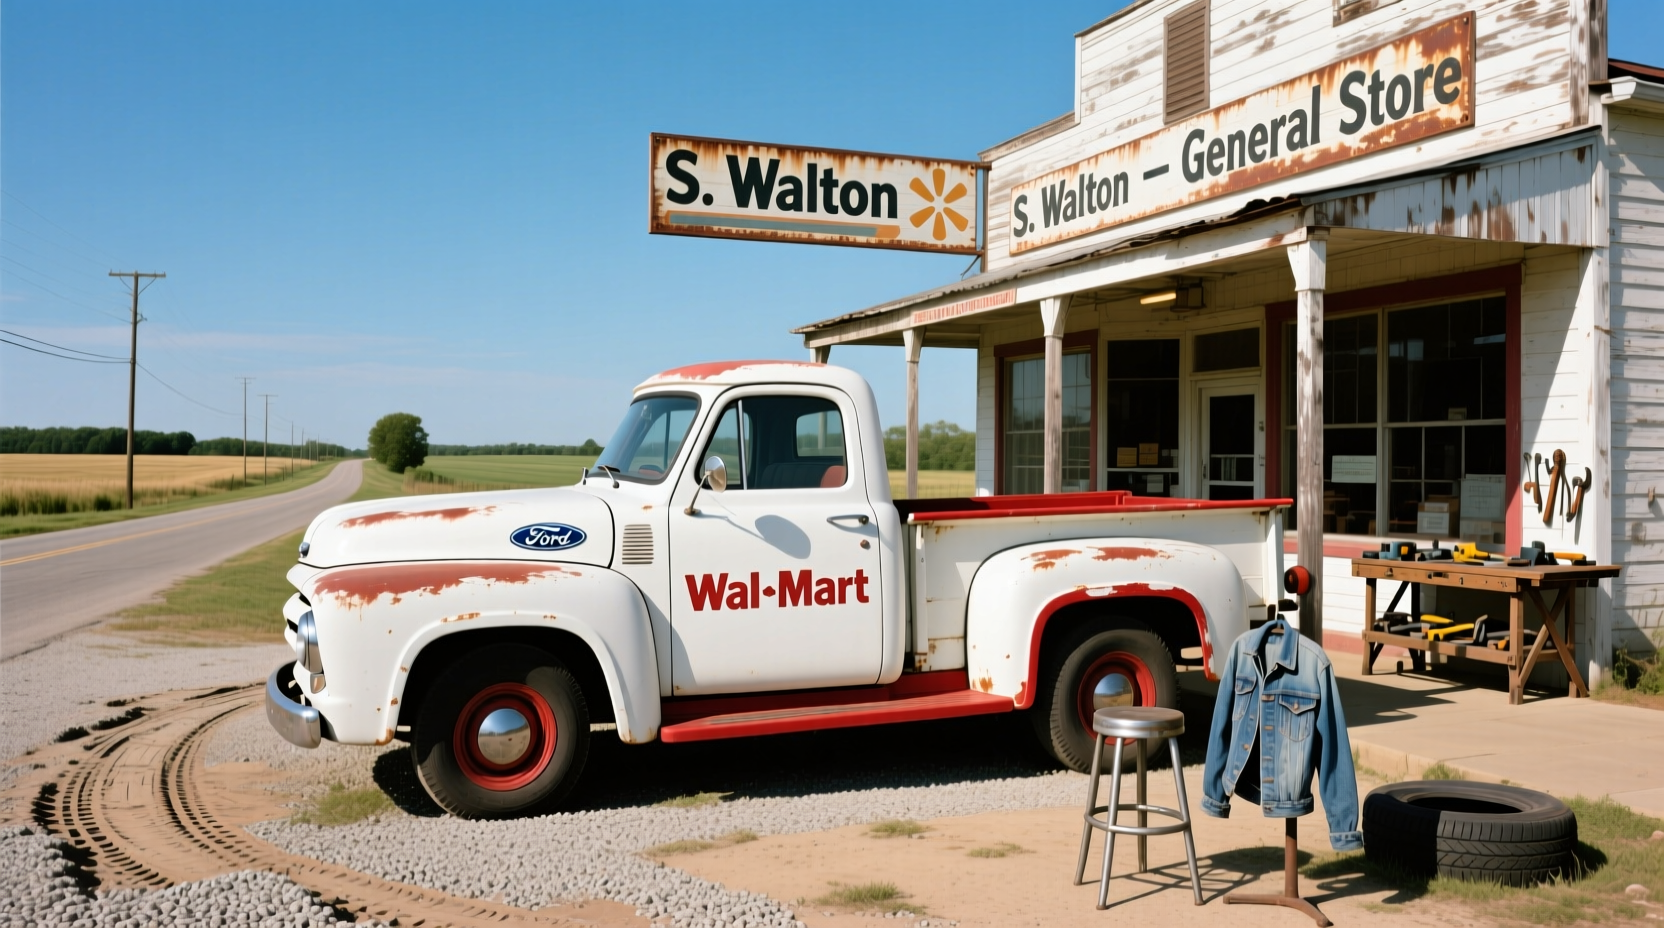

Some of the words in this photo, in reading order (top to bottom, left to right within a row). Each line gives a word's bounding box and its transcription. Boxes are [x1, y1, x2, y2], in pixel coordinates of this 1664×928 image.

[1013, 194, 1035, 238] S.
[1041, 171, 1129, 229] Walton
[1181, 85, 1321, 184] General
[1339, 56, 1462, 135] Store
[665, 148, 714, 206] S.
[725, 154, 898, 219] Walton
[525, 525, 571, 547] Ford
